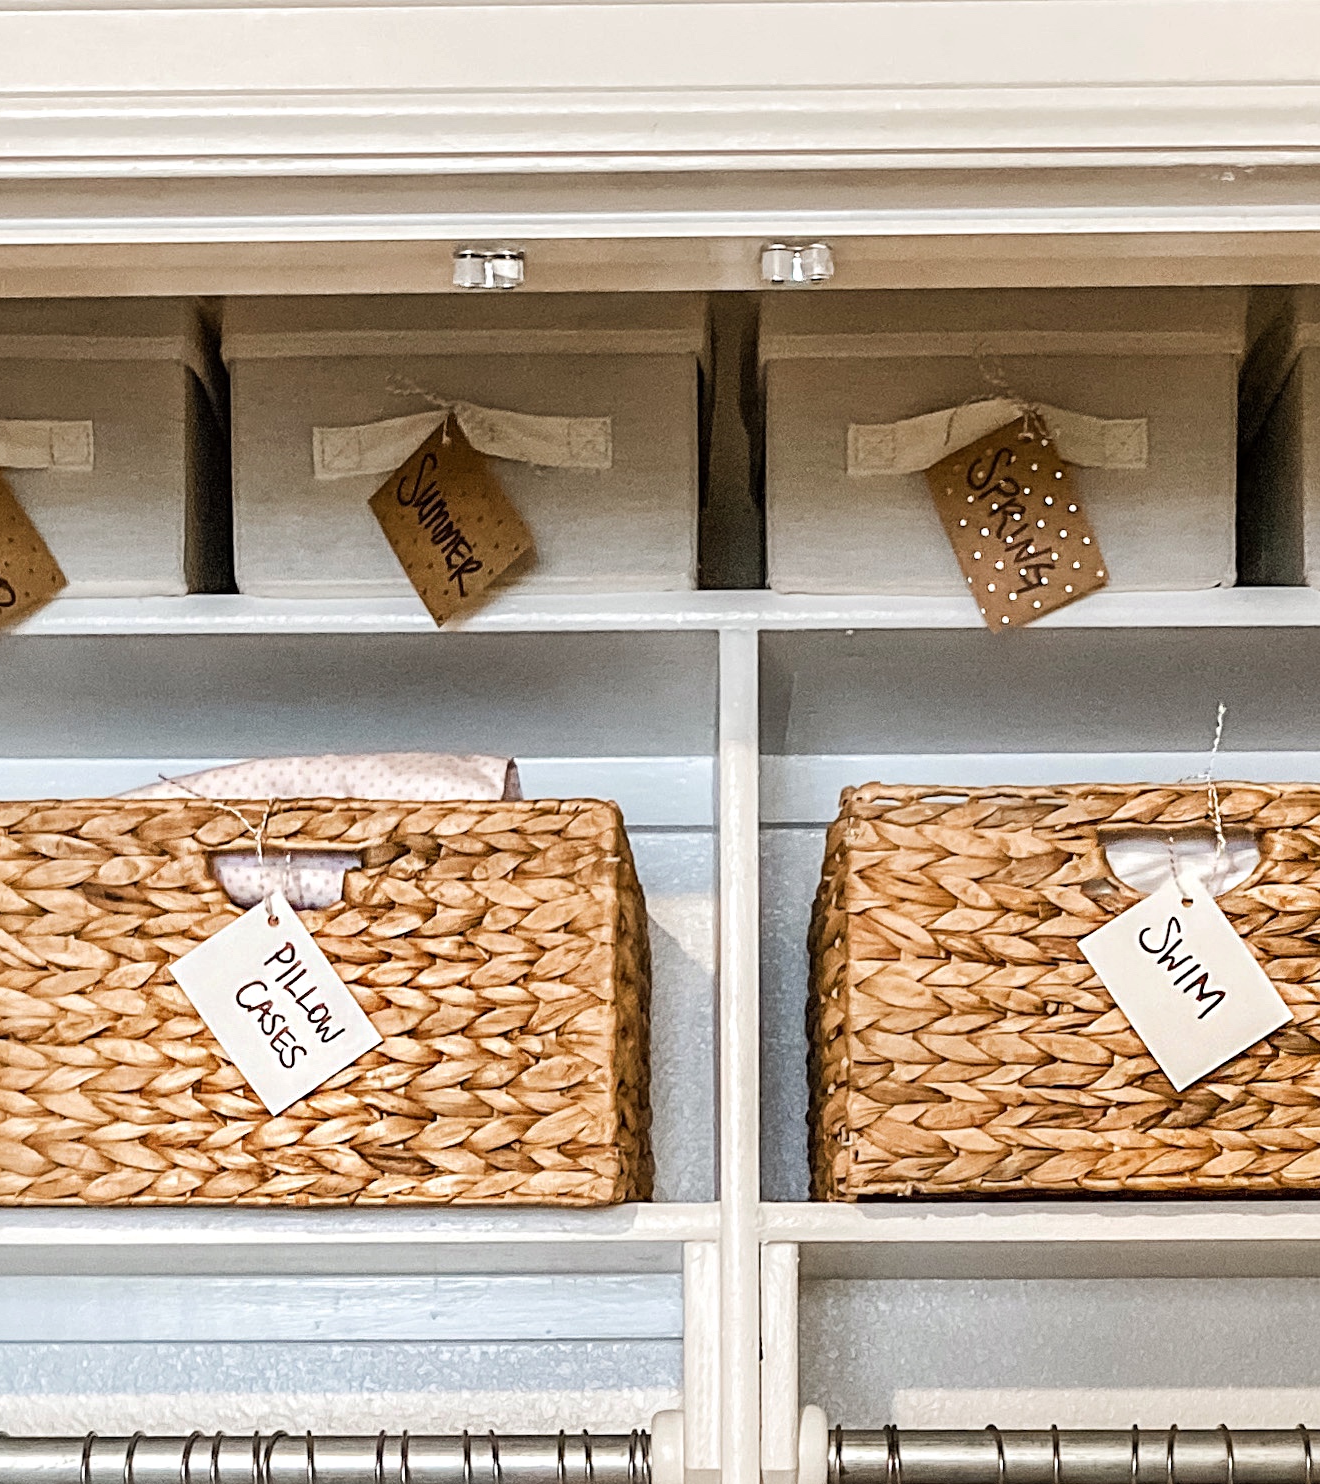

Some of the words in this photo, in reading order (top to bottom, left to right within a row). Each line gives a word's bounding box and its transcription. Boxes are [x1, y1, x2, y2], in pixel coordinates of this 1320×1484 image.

[397, 452, 483, 597] SUMMER
[967, 447, 1056, 594] SPRING
[263, 941, 346, 1043] PILLOW
[1138, 916, 1227, 1020] SWIM
[235, 981, 307, 1068] CASES
